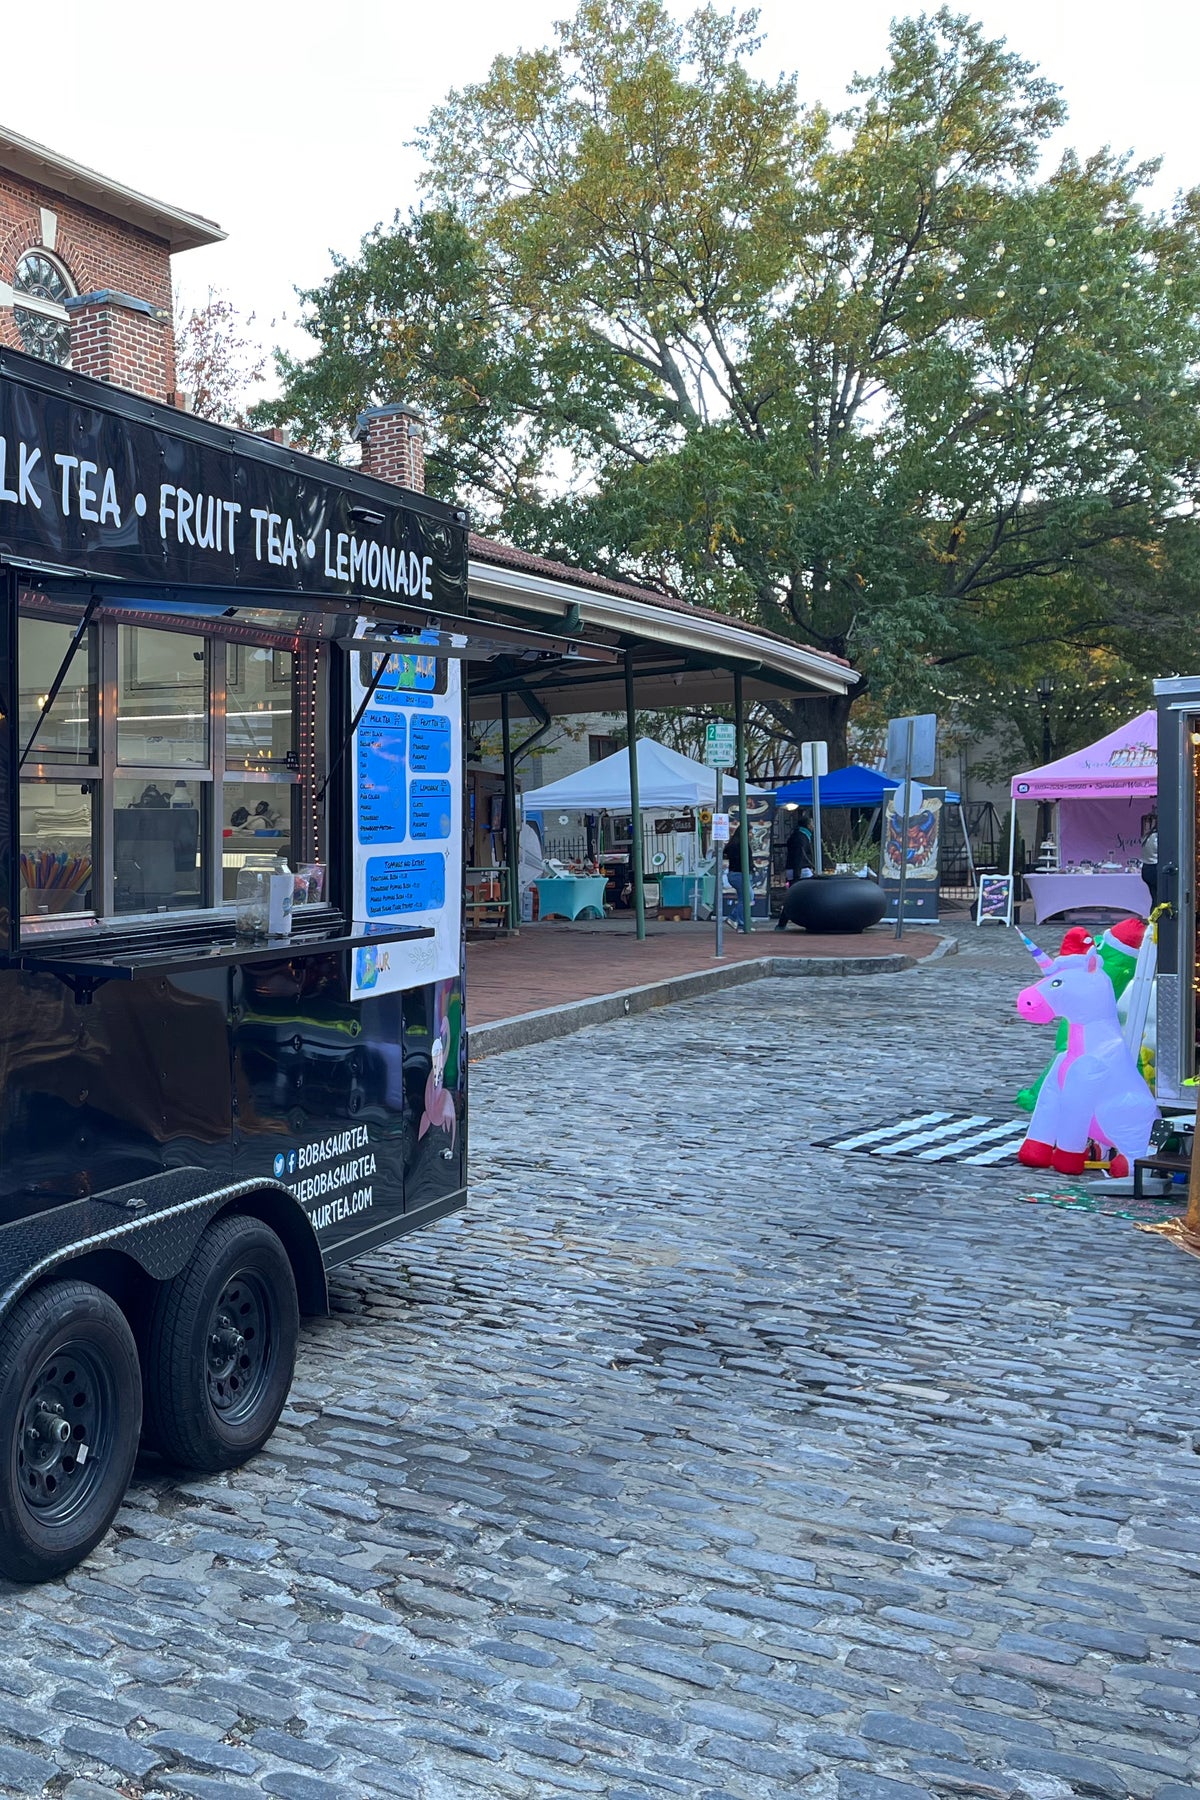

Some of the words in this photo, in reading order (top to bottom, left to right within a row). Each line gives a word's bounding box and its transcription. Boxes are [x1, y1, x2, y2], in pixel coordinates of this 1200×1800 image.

[54, 453, 122, 528] TEA
[158, 483, 242, 555] FRUIT
[250, 506, 298, 570] TEA
[324, 528, 433, 600] LEMONADE
[709, 727, 715, 738] 2
[298, 1124, 369, 1169] BOBASAURTEA
[307, 1185, 373, 1230] AURTEA.COM
